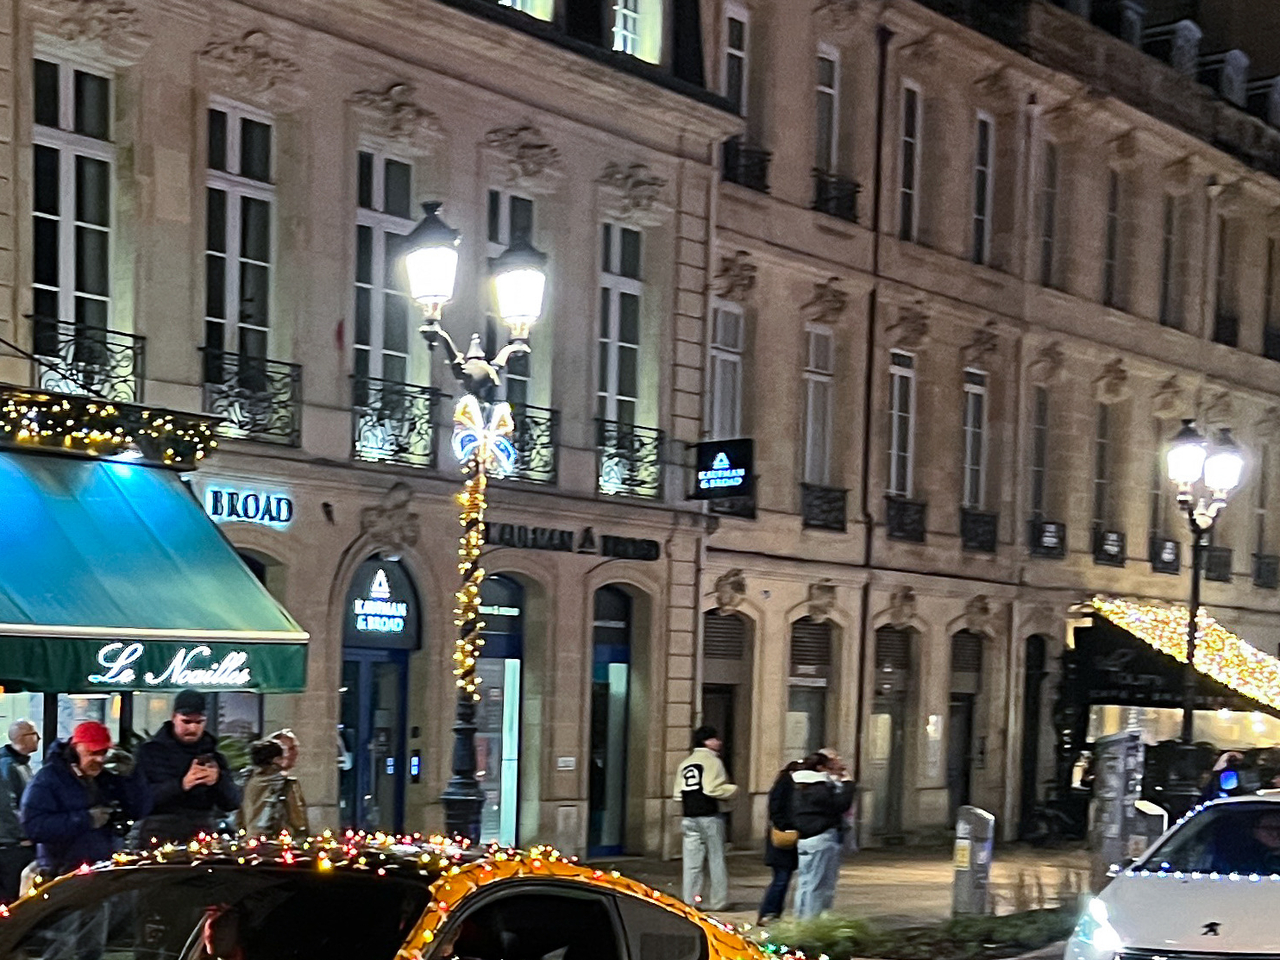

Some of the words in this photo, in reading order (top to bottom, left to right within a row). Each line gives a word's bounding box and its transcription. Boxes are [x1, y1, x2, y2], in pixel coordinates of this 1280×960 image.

[210, 490, 294, 522] BROAD
[87, 641, 144, 684] Le
[143, 645, 251, 685] Noailles
